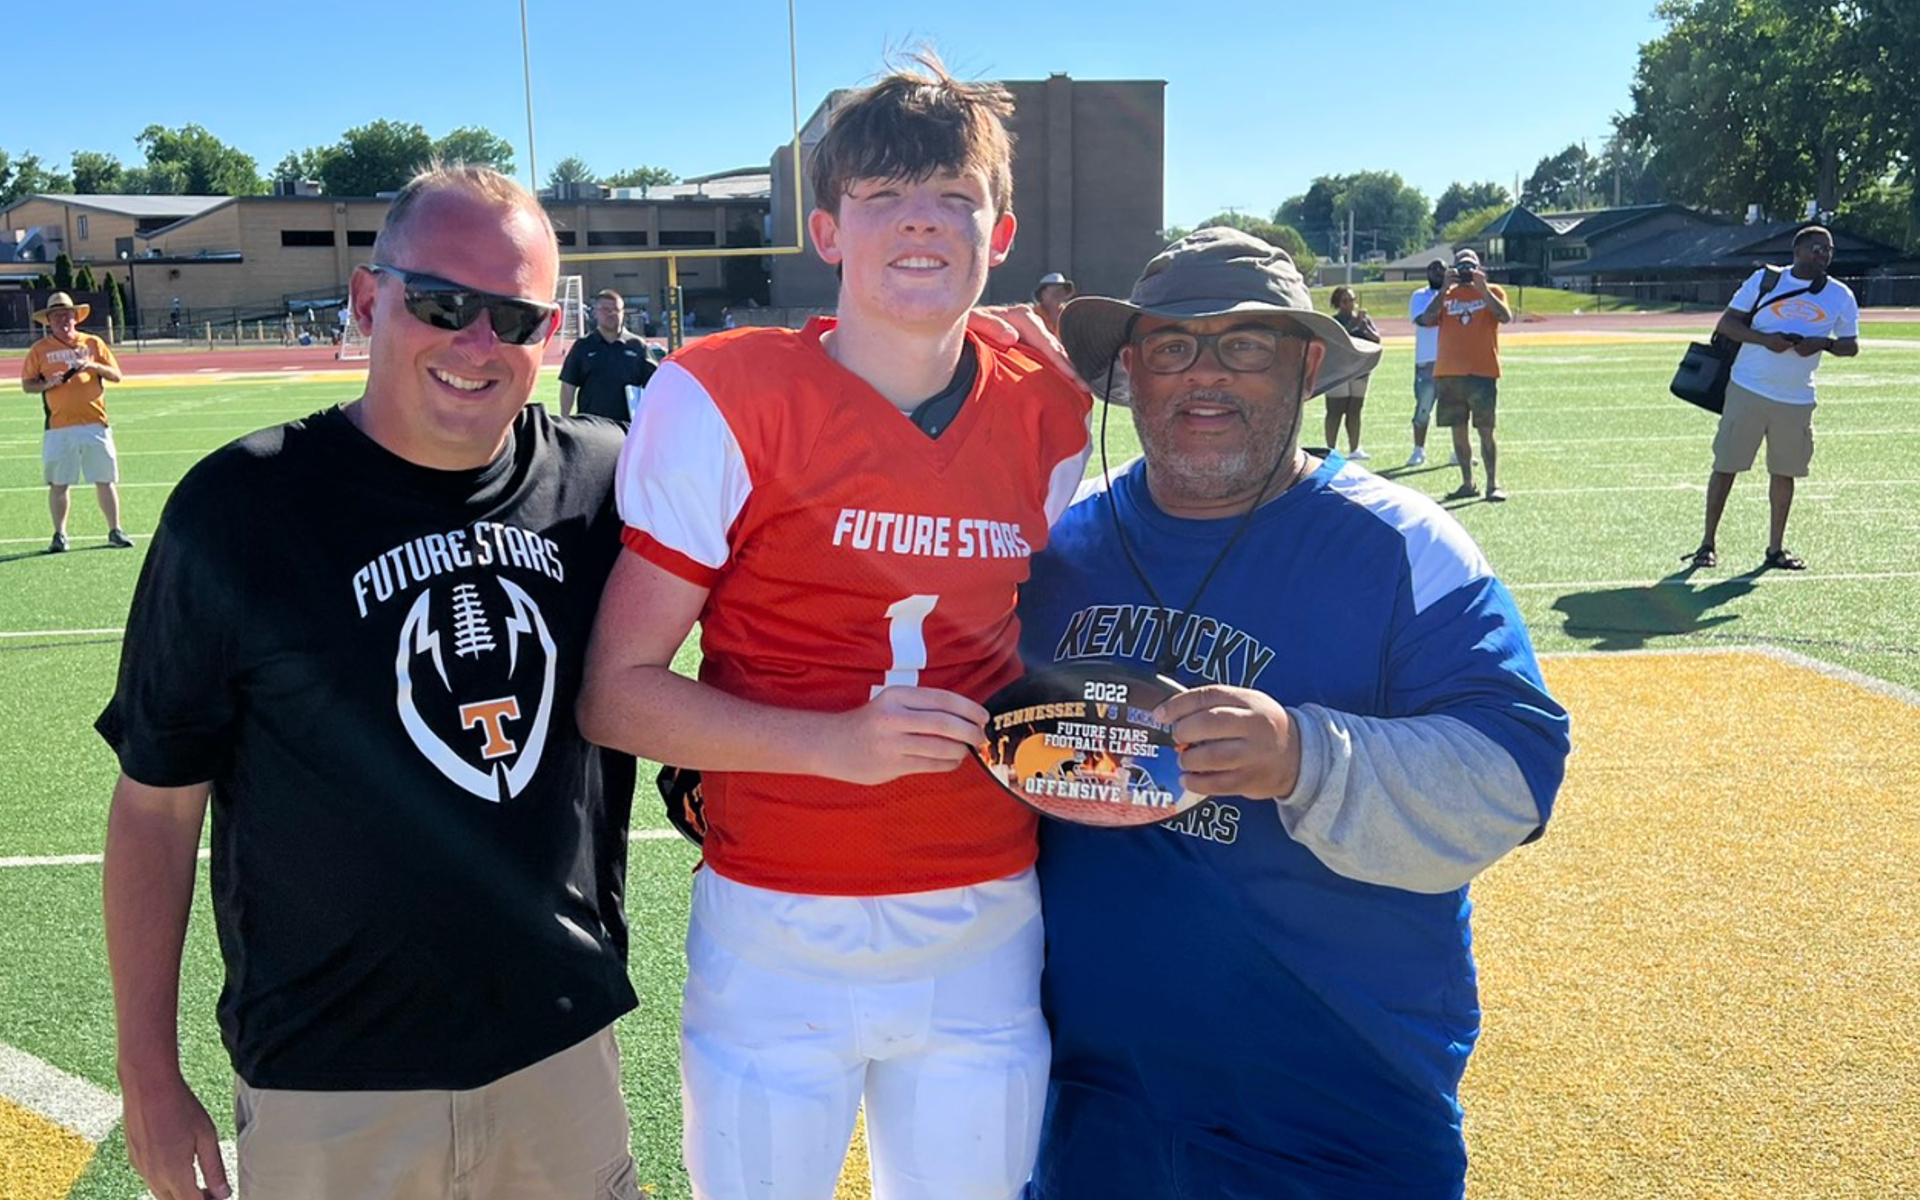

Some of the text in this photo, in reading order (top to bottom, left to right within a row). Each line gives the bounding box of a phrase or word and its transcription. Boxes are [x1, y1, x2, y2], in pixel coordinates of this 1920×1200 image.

[832, 509, 1032, 559] FUTURE STARS
[352, 521, 564, 619] FUTURE STARS
[869, 594, 940, 700] 1
[1053, 604, 1276, 690] KENTUCKY
[1084, 681, 1128, 703] 2022
[458, 695, 521, 760] T
[993, 702, 1086, 730] TENNESSEE
[1096, 702, 1119, 721] VS
[1056, 721, 1149, 744] FUTURE STARS
[1044, 733, 1159, 758] FOOTBALL CLASSIC
[1025, 777, 1173, 808] OFFENSIVE MVP
[1160, 800, 1241, 845] ARS
